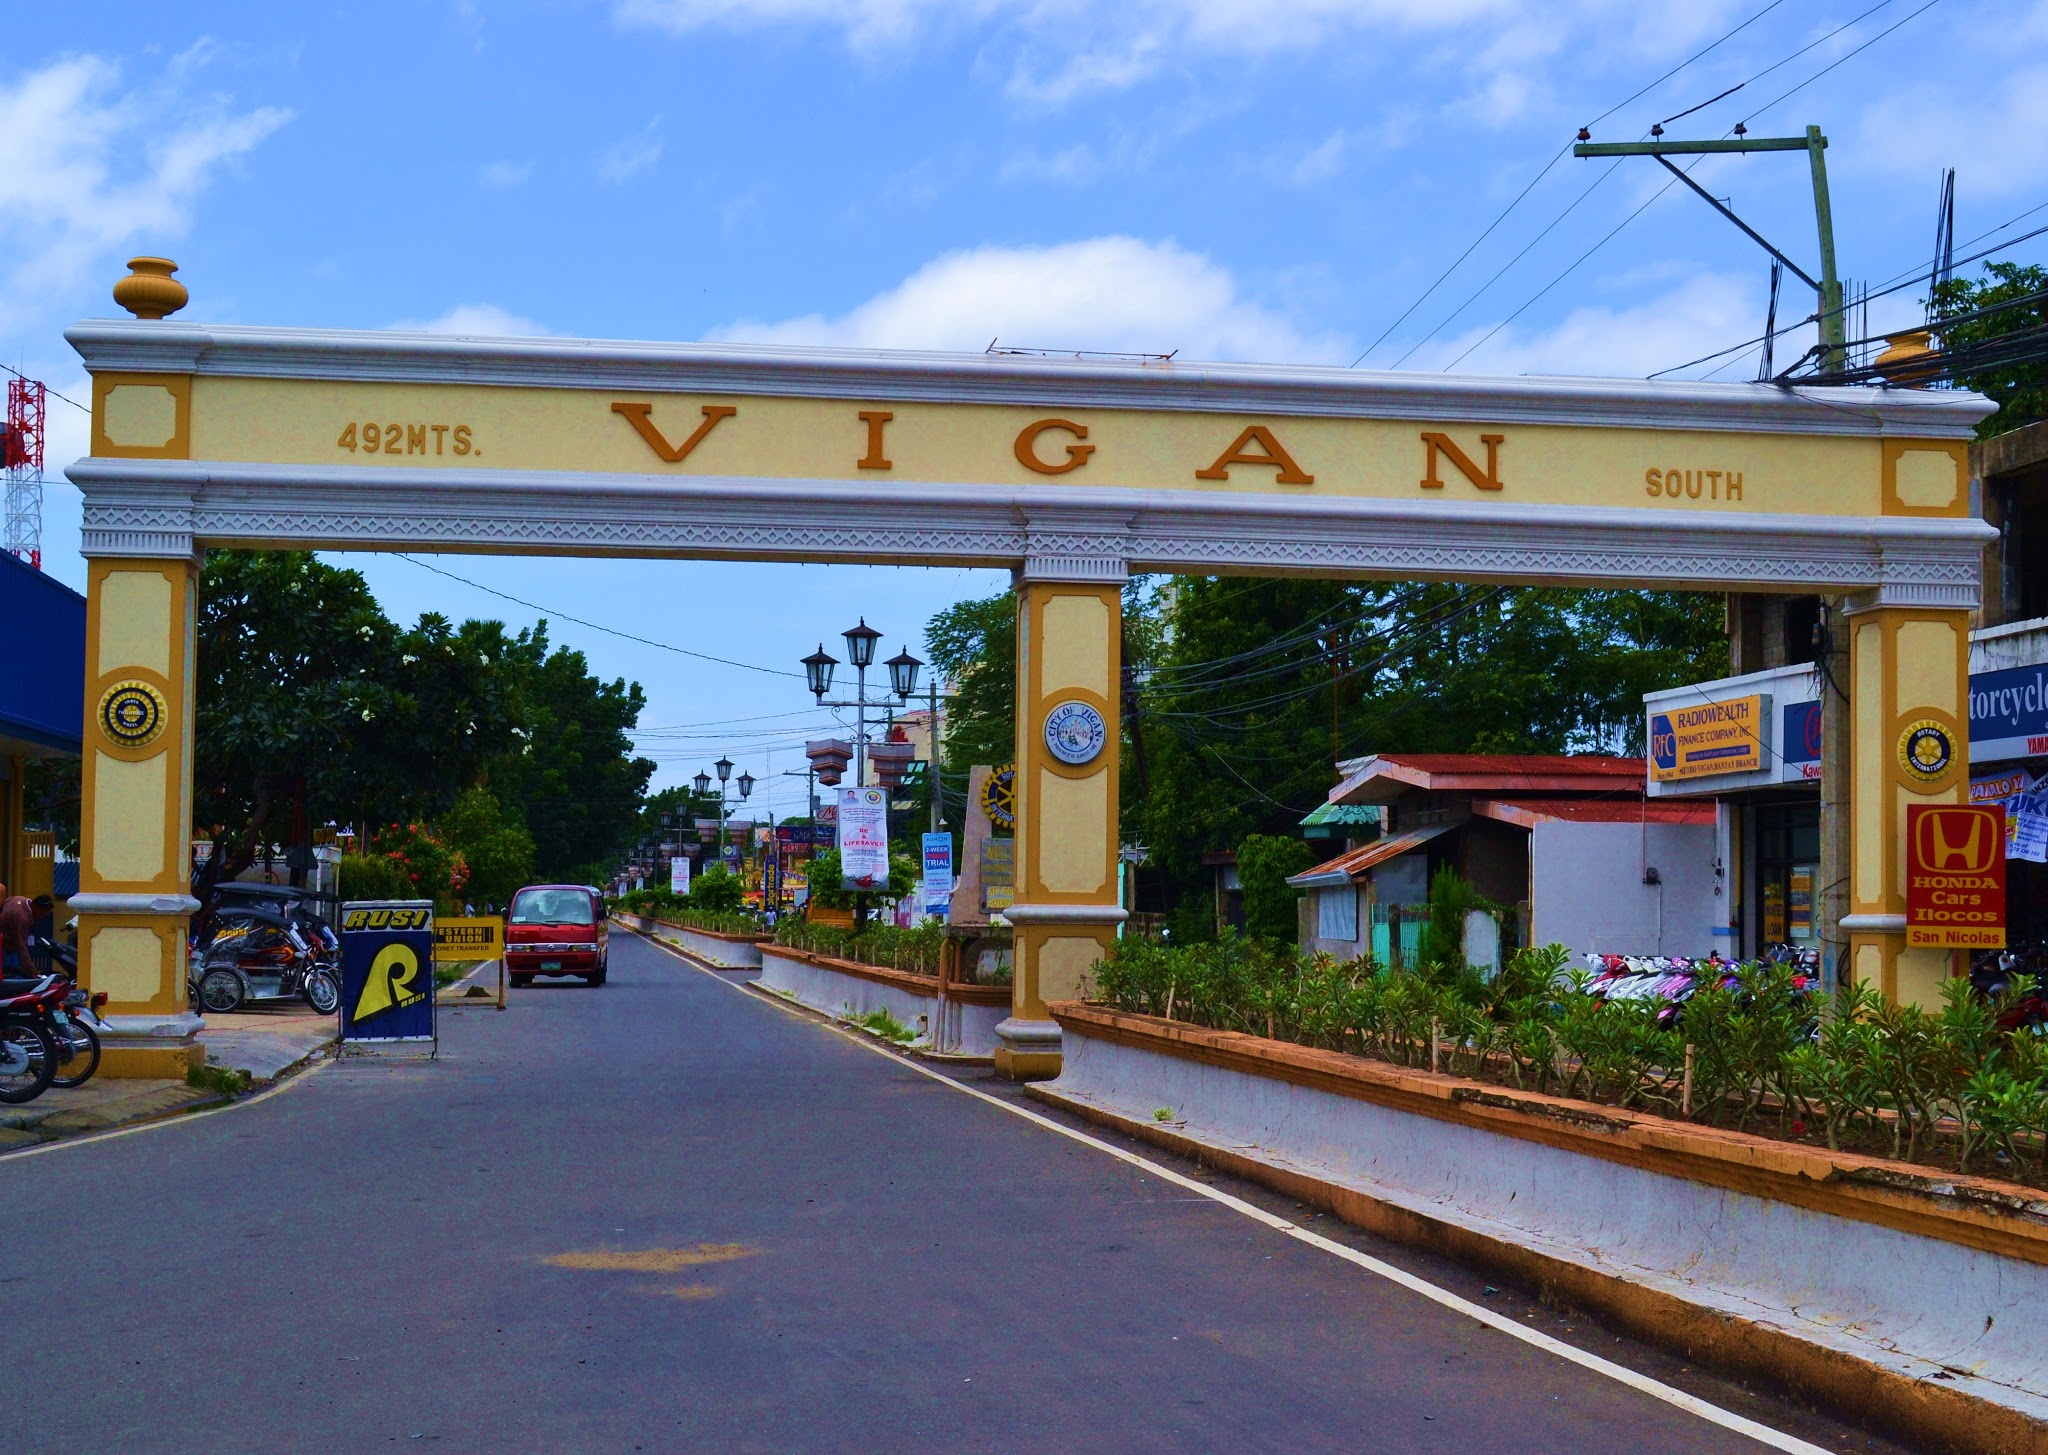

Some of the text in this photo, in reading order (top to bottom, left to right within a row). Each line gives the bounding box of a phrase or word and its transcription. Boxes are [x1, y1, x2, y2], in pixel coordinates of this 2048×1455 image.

[1645, 467, 1744, 501] SOUTH
[1048, 705, 1103, 738] CITY OF VIGAN
[1678, 702, 1749, 729] RADIOWEALTH
[1678, 732, 1705, 747] FINANCE
[1916, 728, 1941, 738] ROTARY
[1654, 733, 1676, 758] RFC
[1736, 758, 1758, 768] BRANCH
[1910, 756, 1948, 772] INTERNATIONAL
[926, 859, 949, 867] TRIAL
[1912, 876, 2000, 889] HONDA
[988, 898, 1013, 908] ROTARY
[1931, 890, 1982, 906] Cars
[344, 909, 429, 930] RUSI
[1914, 908, 1998, 922] Ilocos
[445, 935, 482, 943] UNION
[1912, 930, 2000, 944] San Nicolas
[401, 993, 426, 1008] RUSI
